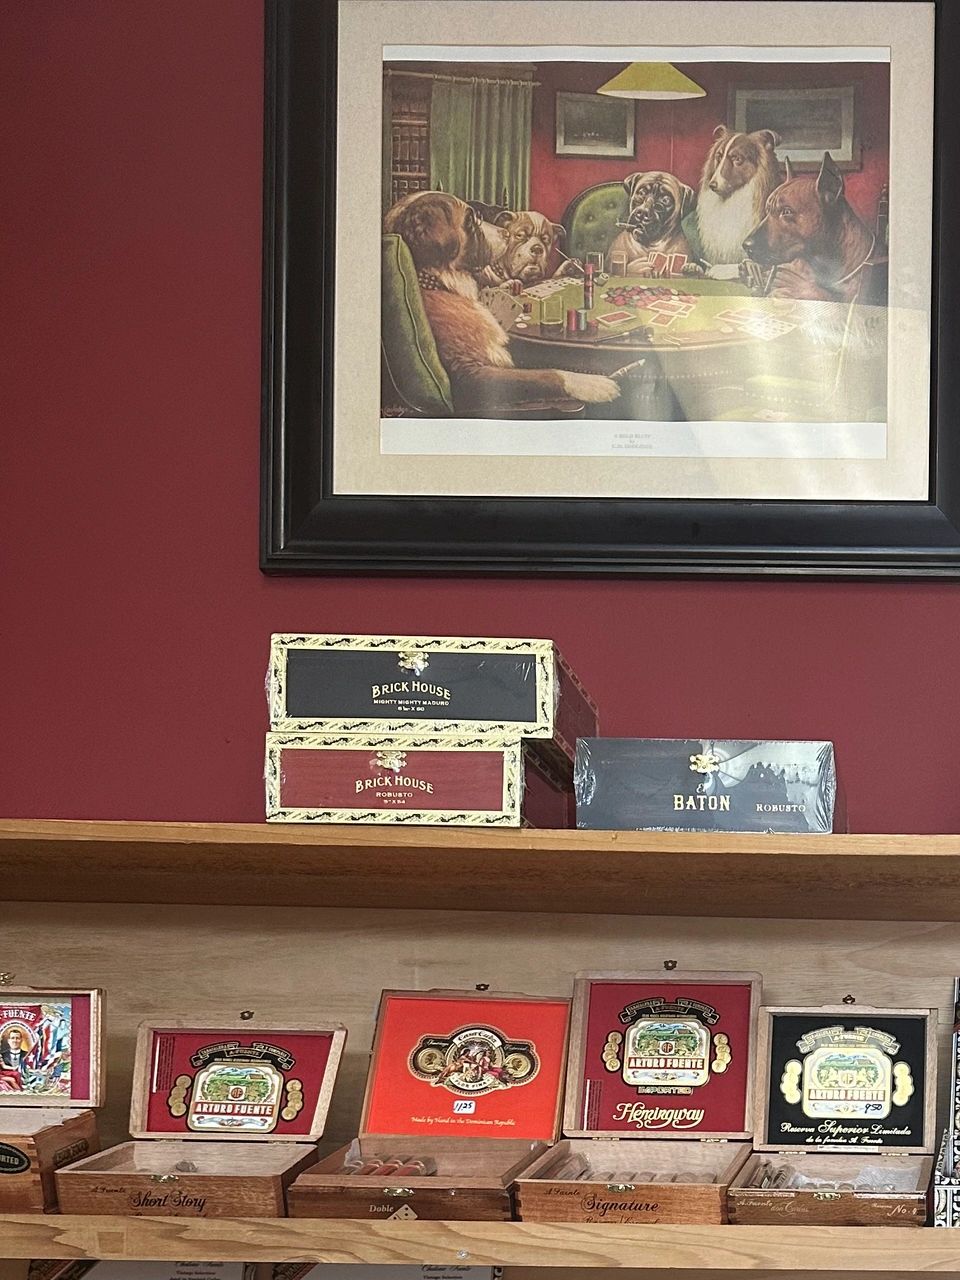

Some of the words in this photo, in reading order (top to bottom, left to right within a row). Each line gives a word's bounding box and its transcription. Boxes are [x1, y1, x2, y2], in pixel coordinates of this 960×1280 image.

[372, 681, 409, 698] BRICK
[412, 680, 451, 700] HOUSE
[355, 776, 392, 793] BRICK
[395, 775, 434, 794] HOUSE
[673, 794, 730, 811] BATON
[756, 804, 806, 812] ROBUSTO
[629, 1058, 665, 1068] ARTURO
[666, 1059, 703, 1069] FUENTE
[810, 1089, 846, 1100] ARTURO
[847, 1089, 884, 1100] FUENTE
[196, 1103, 233, 1113] ARTURO
[234, 1104, 274, 1115] FUENTE
[613, 1102, 705, 1128] Hemingway
[818, 1120, 869, 1137] Superior
[870, 1124, 911, 1135] Limitada
[129, 1191, 169, 1208] Short
[170, 1191, 207, 1212] Story
[369, 1204, 394, 1213] Doble
[581, 1193, 659, 1217] Signature
